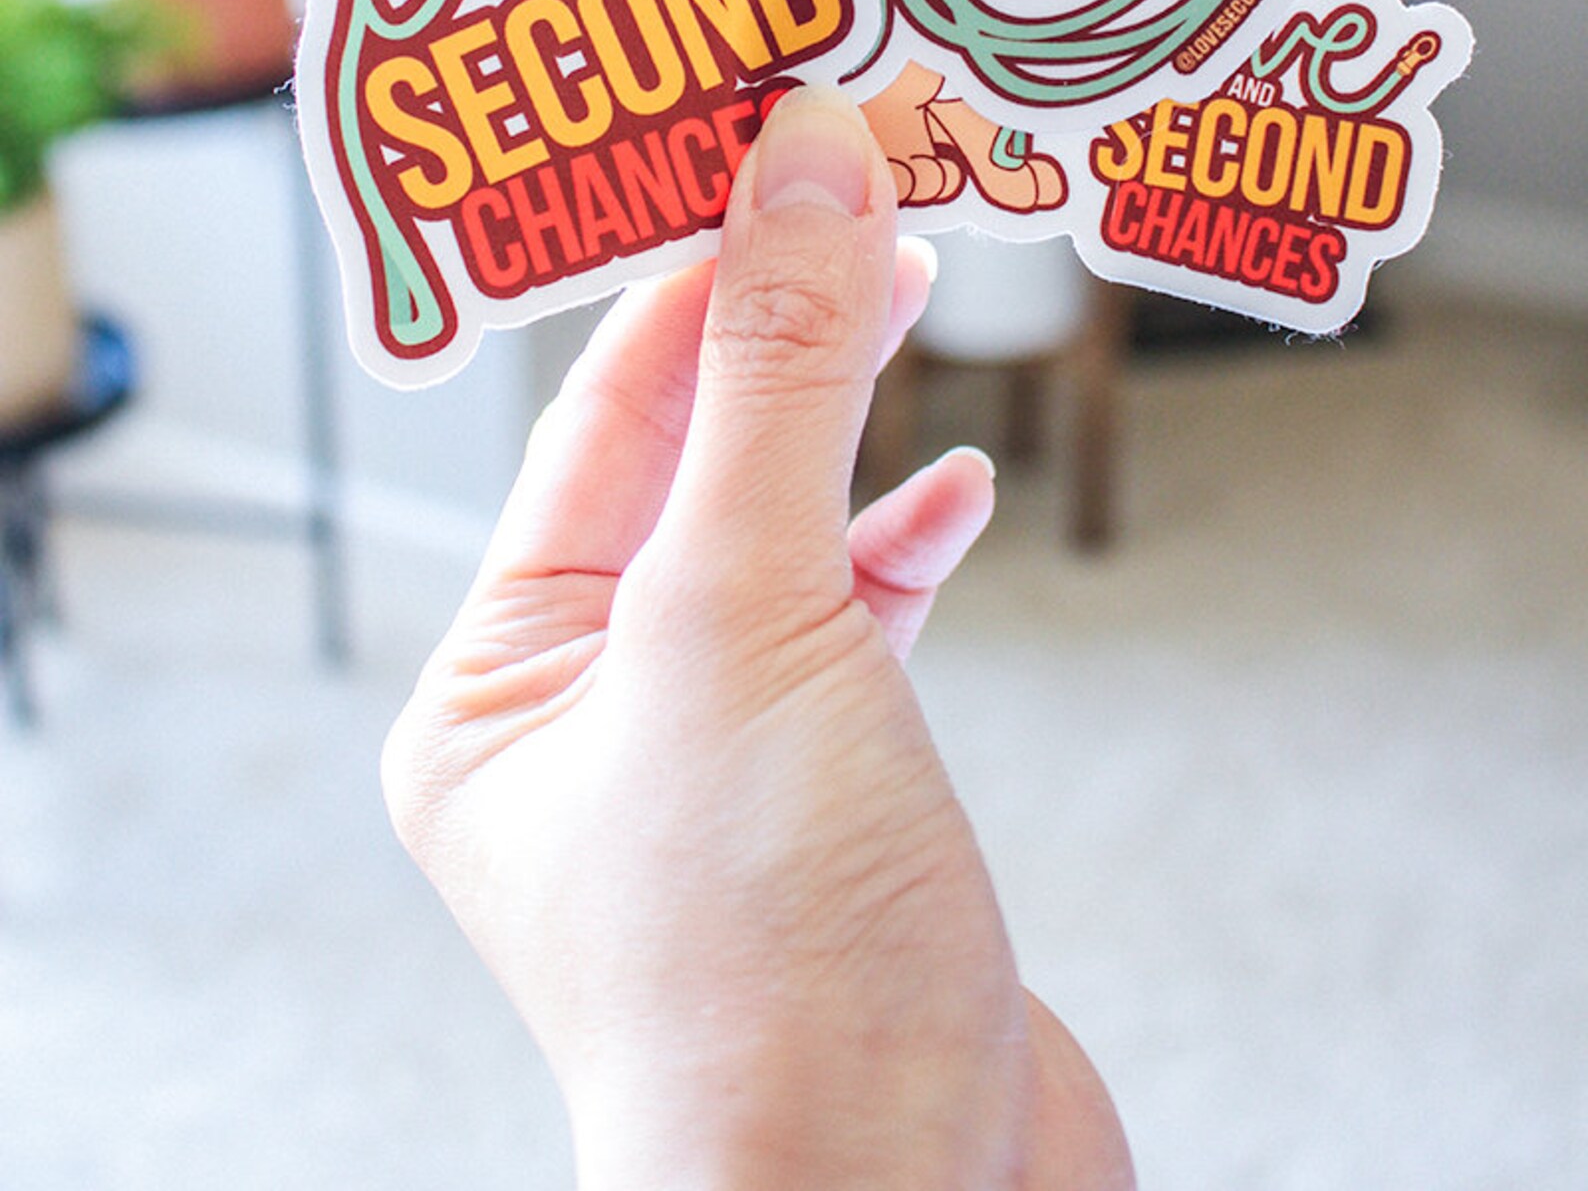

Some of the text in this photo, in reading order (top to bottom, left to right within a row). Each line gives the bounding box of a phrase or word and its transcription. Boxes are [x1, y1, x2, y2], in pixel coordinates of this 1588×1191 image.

[1227, 74, 1276, 108] AND
[461, 88, 789, 289] CHANCE
[1096, 97, 1406, 225] SECOND
[1107, 181, 1342, 299] CHANCES
